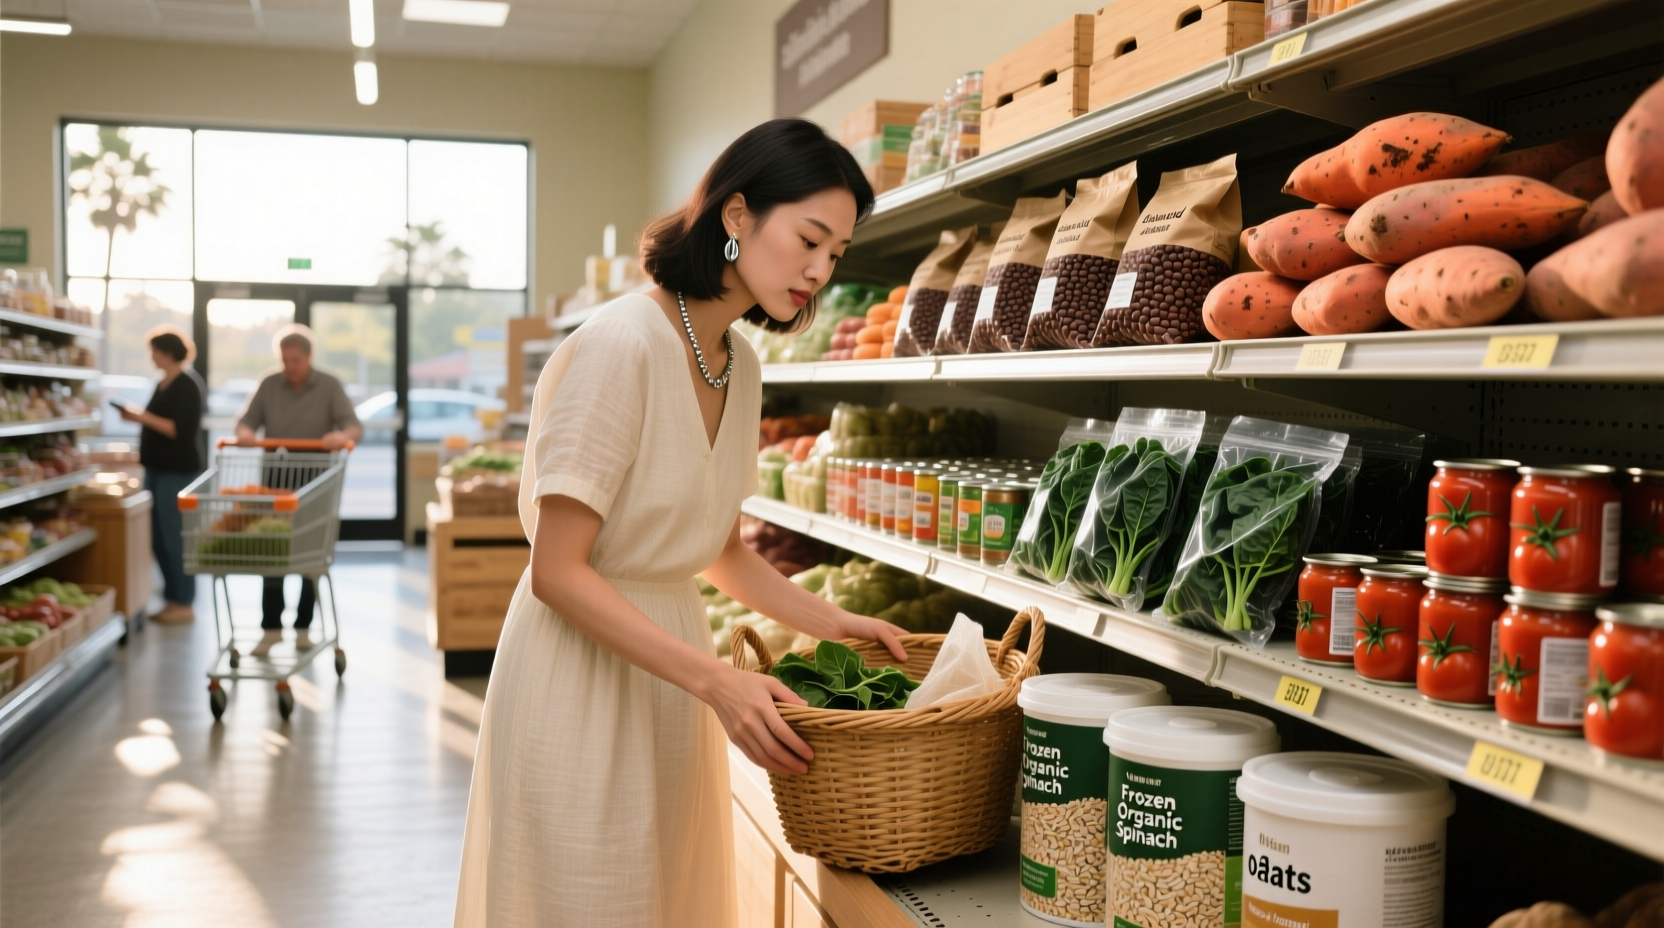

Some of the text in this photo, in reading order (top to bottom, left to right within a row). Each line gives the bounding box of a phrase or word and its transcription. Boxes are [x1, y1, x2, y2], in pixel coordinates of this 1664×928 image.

[1121, 783, 1176, 811] Frozen
[1117, 801, 1183, 831] Organic
[1115, 820, 1177, 849] Spinach
